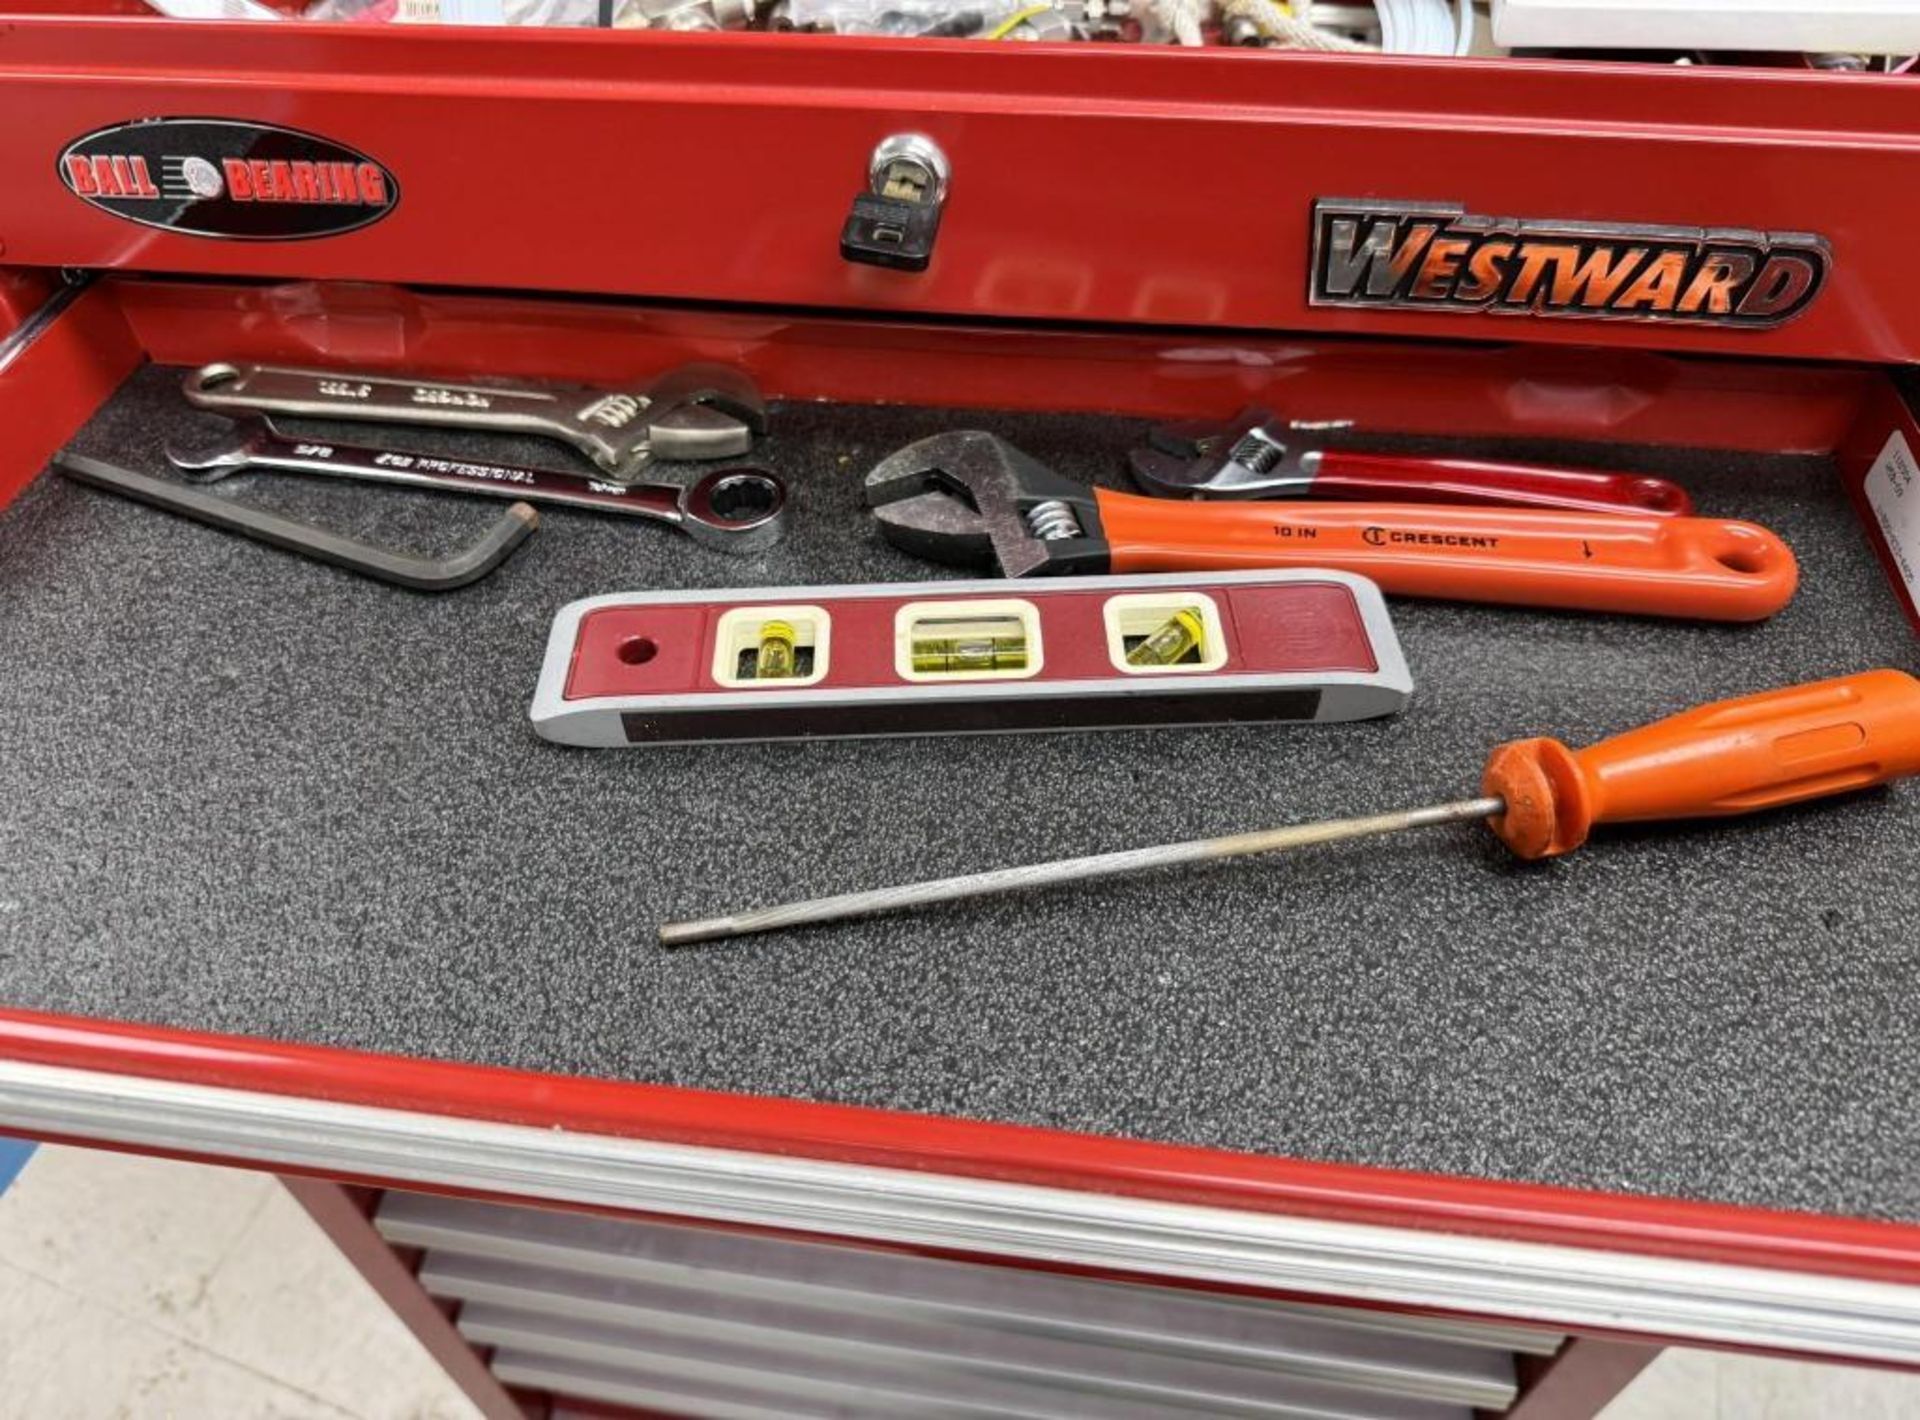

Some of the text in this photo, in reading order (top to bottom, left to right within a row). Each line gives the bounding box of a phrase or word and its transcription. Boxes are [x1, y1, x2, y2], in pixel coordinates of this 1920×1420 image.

[66, 155, 387, 206] BALL BEARING
[1273, 525, 1317, 539] 10 IN
[1390, 531, 1499, 547] CRESCENT
